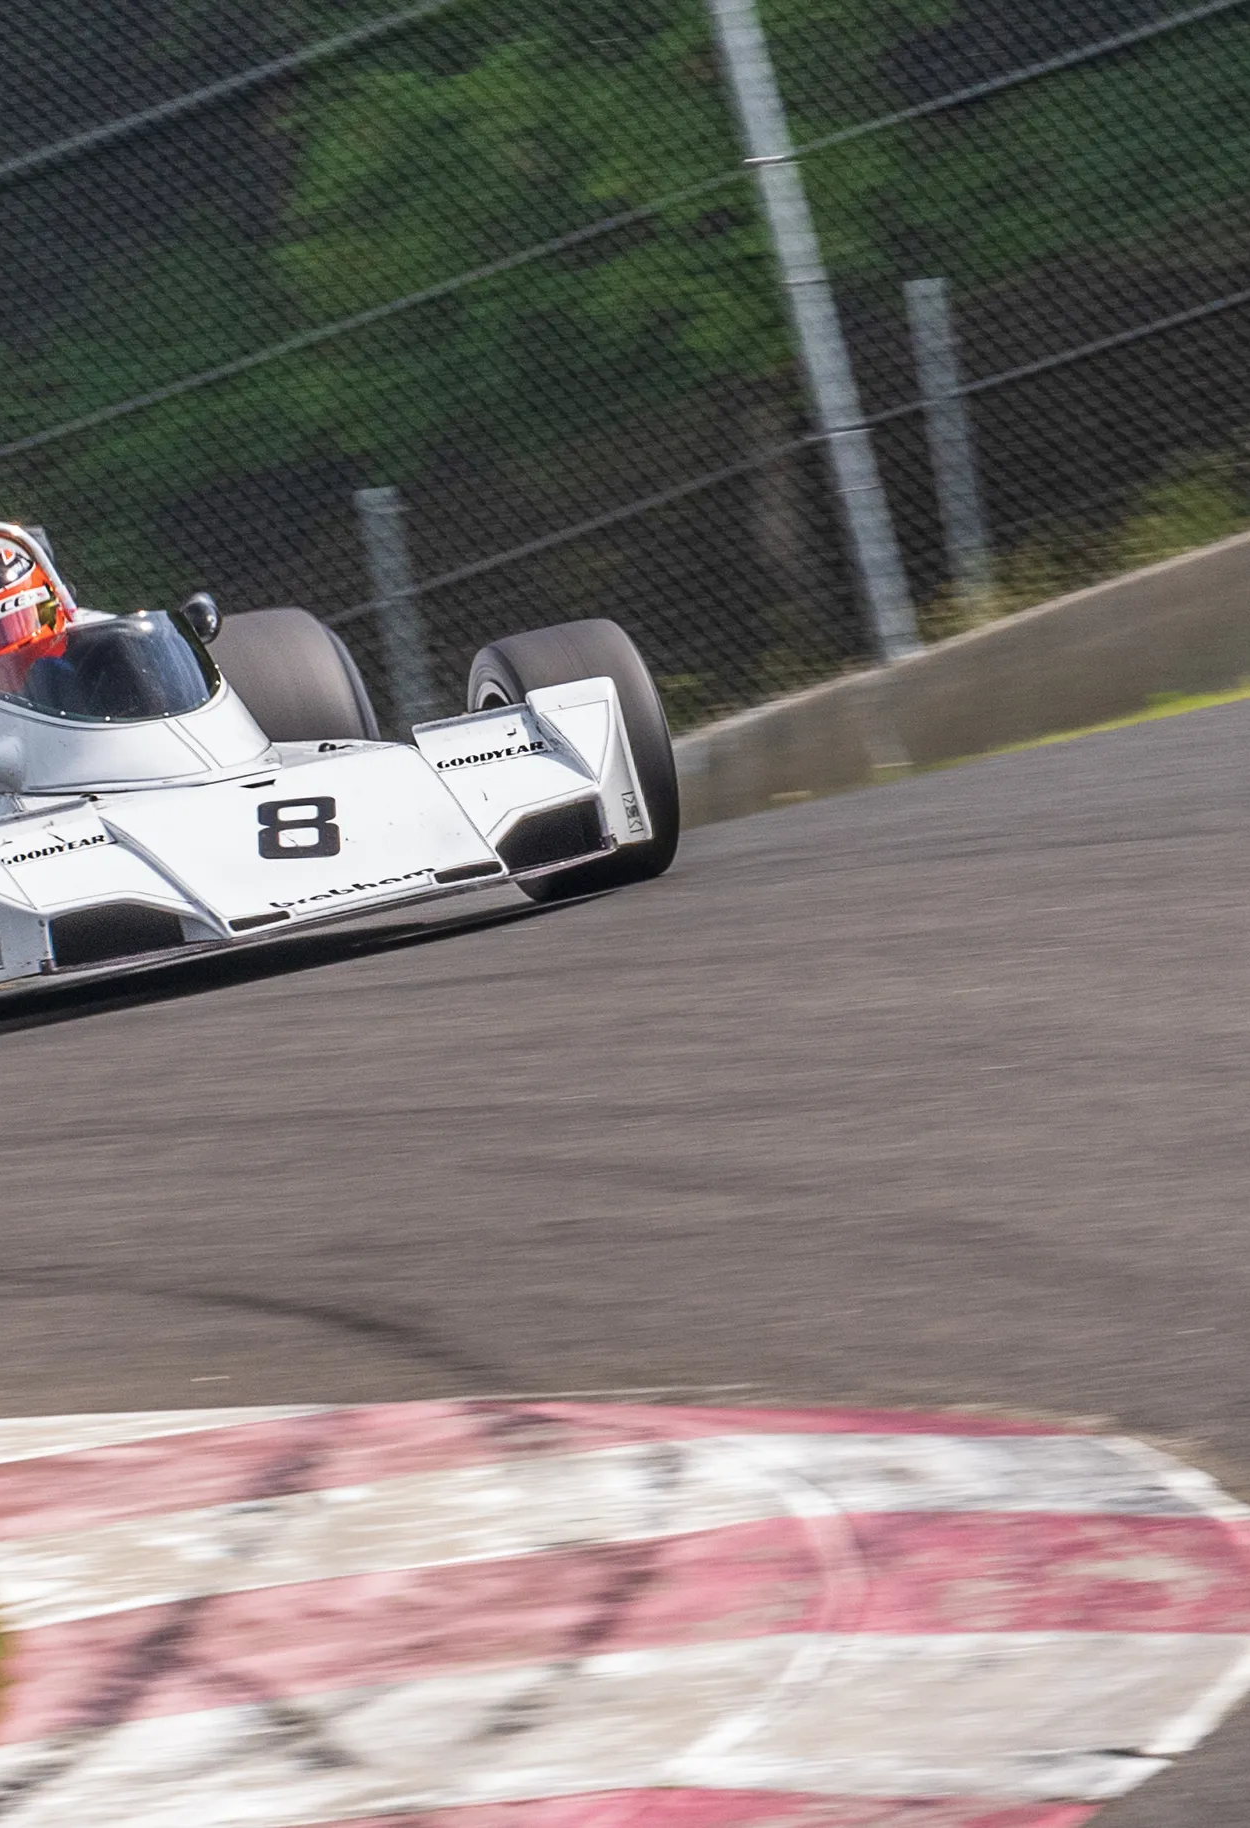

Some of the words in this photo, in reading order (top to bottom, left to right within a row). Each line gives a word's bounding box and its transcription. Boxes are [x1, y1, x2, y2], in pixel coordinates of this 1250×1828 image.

[436, 741, 545, 769] GOODYEAR
[257, 795, 341, 860] 8
[0, 834, 106, 865] GOODYEAR
[269, 867, 435, 908] brabham
